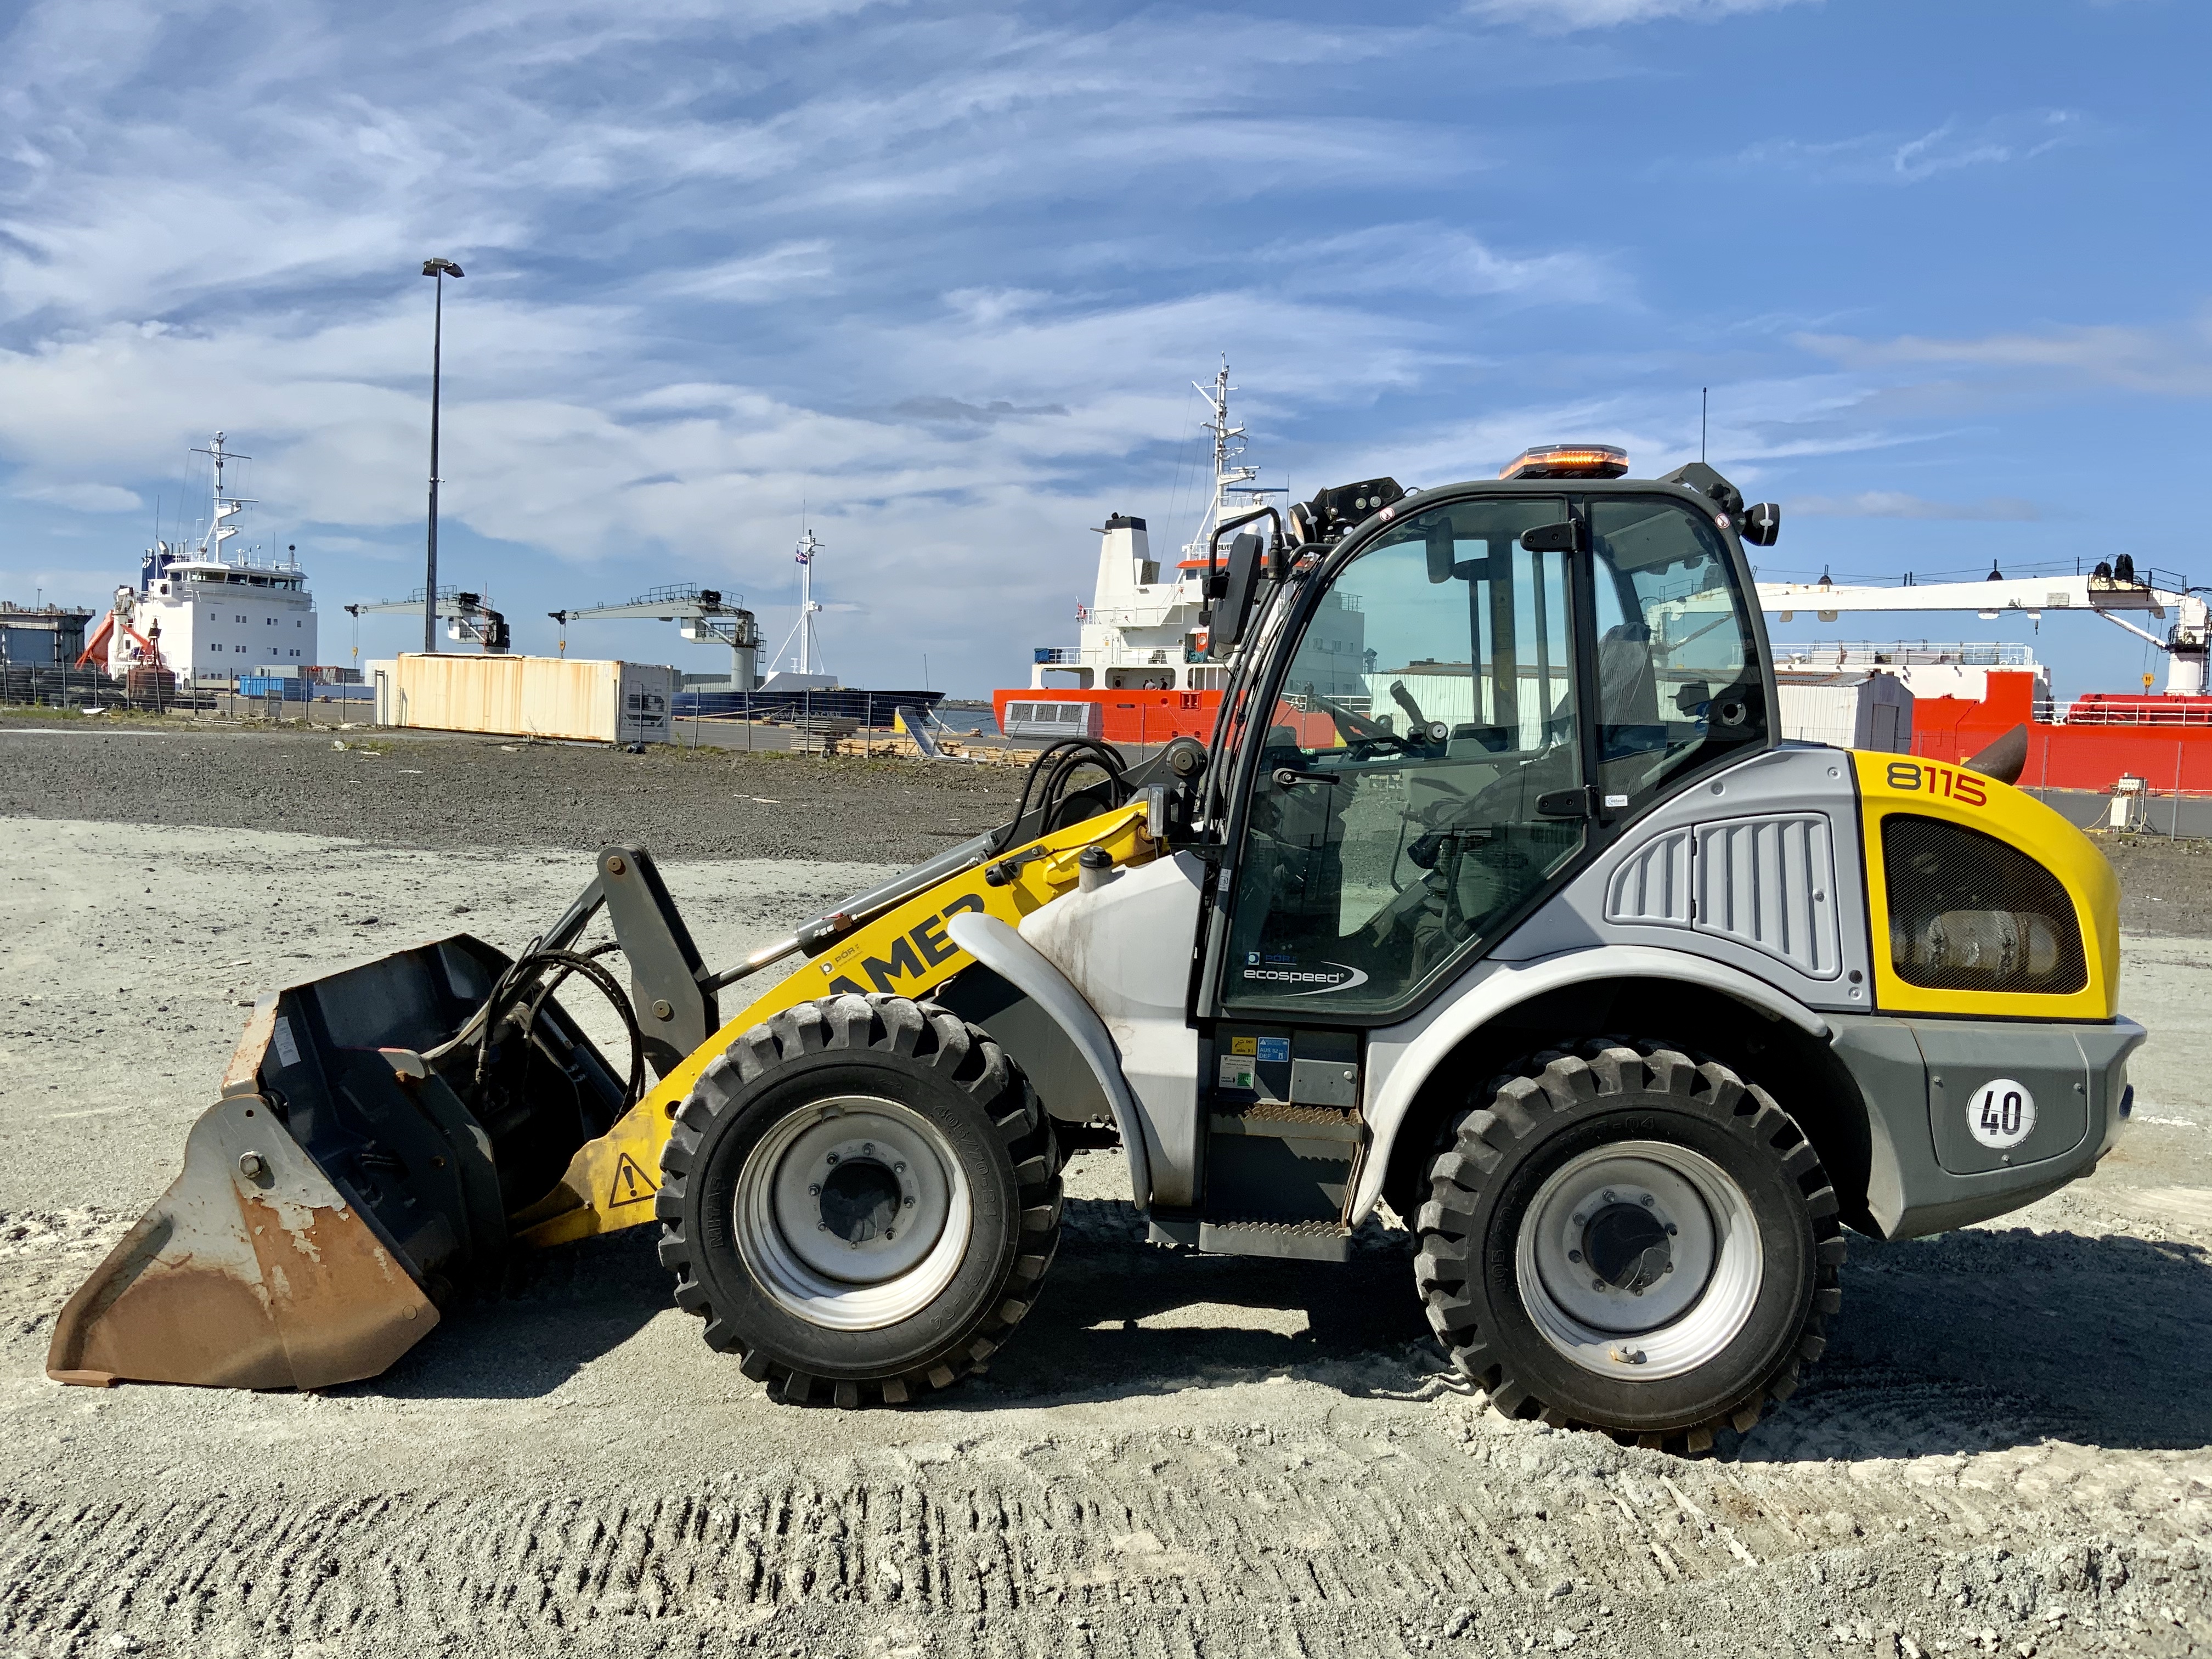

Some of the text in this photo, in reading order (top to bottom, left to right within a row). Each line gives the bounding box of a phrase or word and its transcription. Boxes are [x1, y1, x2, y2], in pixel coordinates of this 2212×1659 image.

[1887, 762, 1987, 807] 8115
[1244, 969, 1340, 983] ecospeed
[1980, 1091, 2022, 1135] 40
[707, 1177, 724, 1249] MITAS
